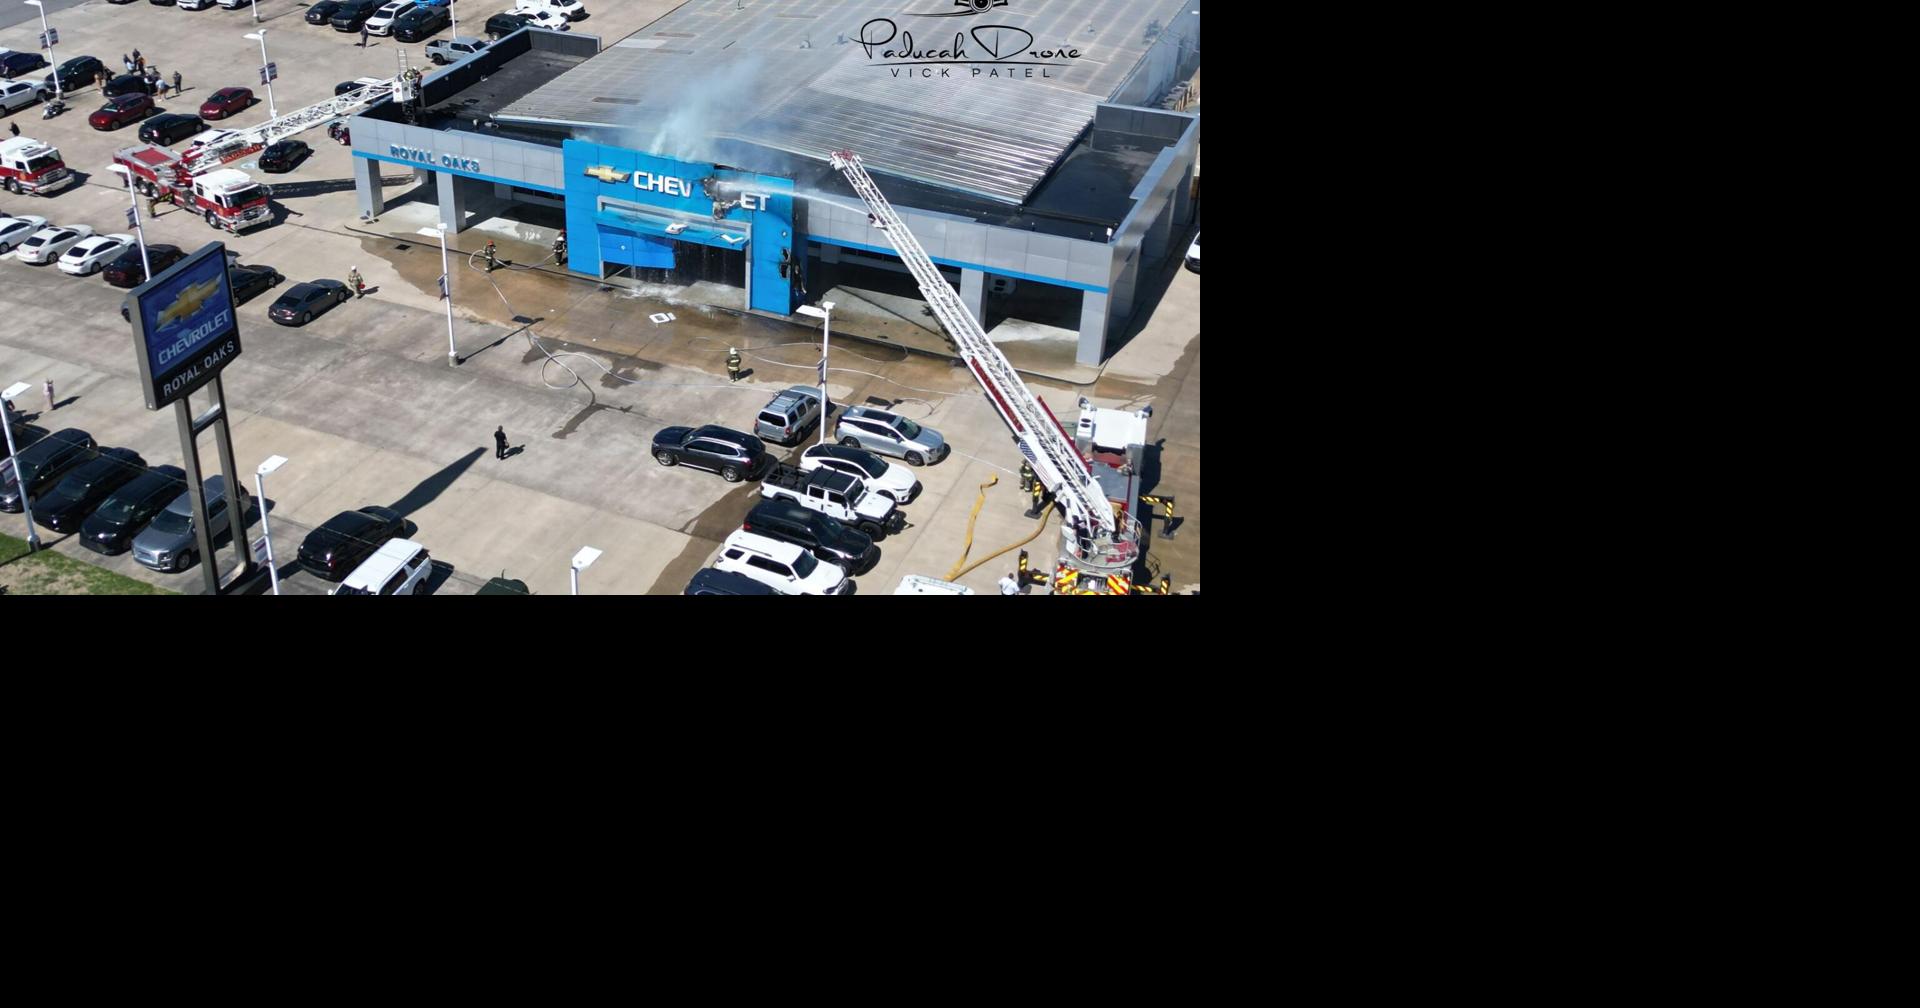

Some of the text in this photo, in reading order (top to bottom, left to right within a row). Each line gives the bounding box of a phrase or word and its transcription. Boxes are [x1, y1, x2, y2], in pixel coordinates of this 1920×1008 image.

[390, 144, 481, 173] ROYAL OAKS
[158, 308, 229, 365] CHEVROLET
[163, 340, 235, 397] ROYAL OAKS
